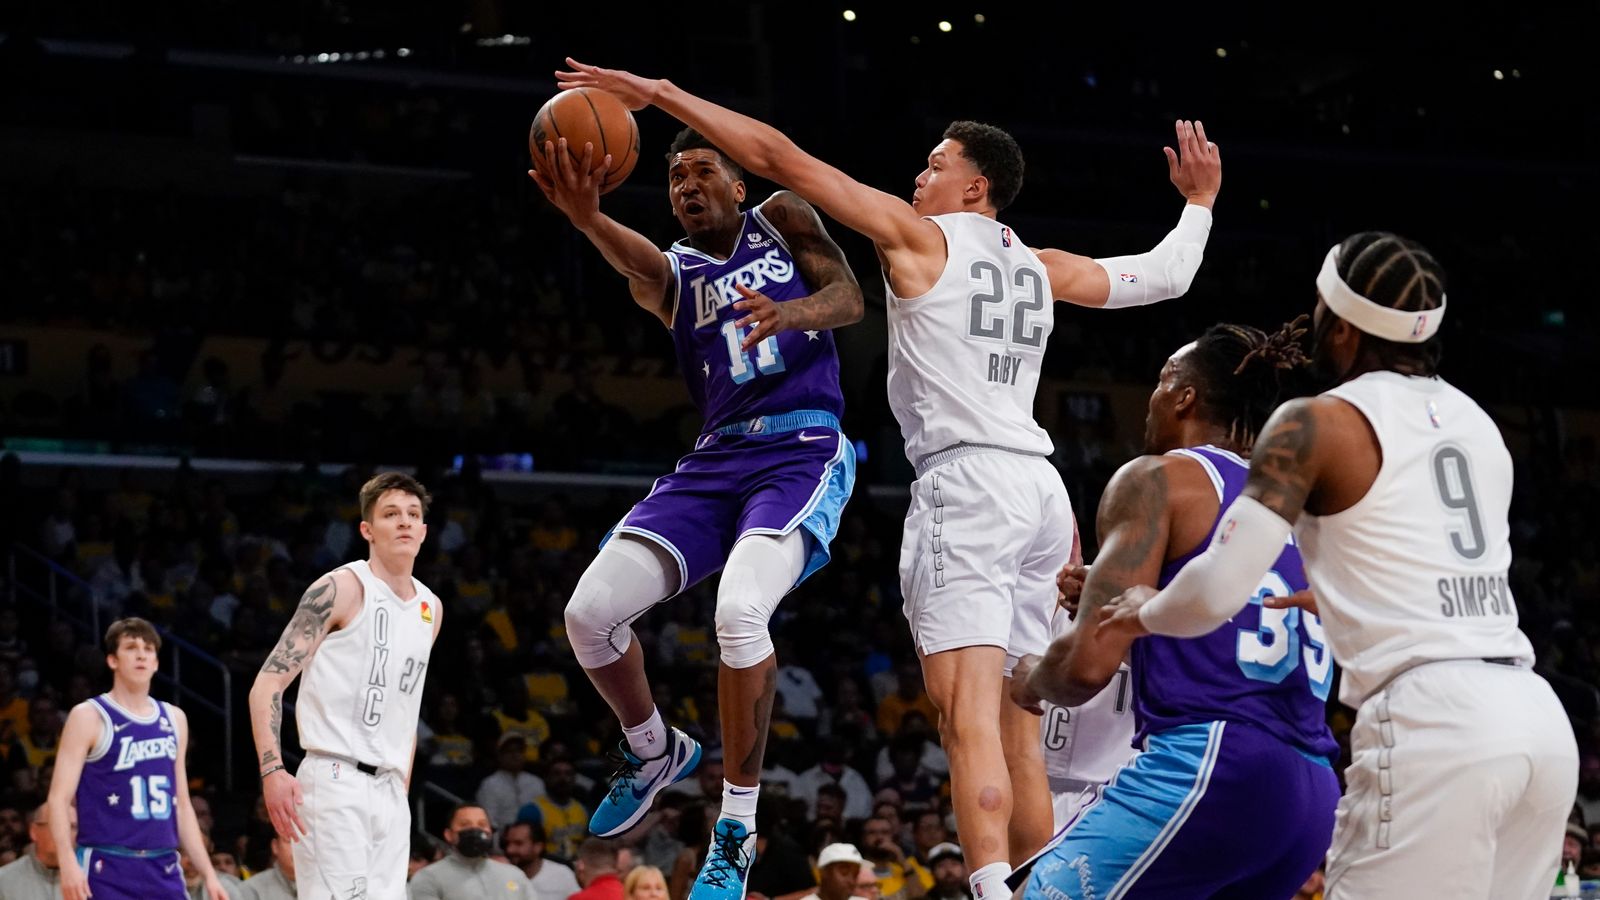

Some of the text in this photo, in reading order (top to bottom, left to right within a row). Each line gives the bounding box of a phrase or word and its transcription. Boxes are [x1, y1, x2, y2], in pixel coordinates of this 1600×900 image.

[747, 239, 774, 249] bibigo
[690, 247, 794, 329] LAKERS
[968, 259, 1046, 349] 22
[720, 319, 784, 383] 11
[1434, 446, 1486, 560] 9
[1437, 575, 1514, 618] SIMPSO
[362, 607, 389, 727] OKC
[399, 657, 427, 696] 27
[113, 735, 178, 771] LAKERS
[129, 775, 172, 820] 15
